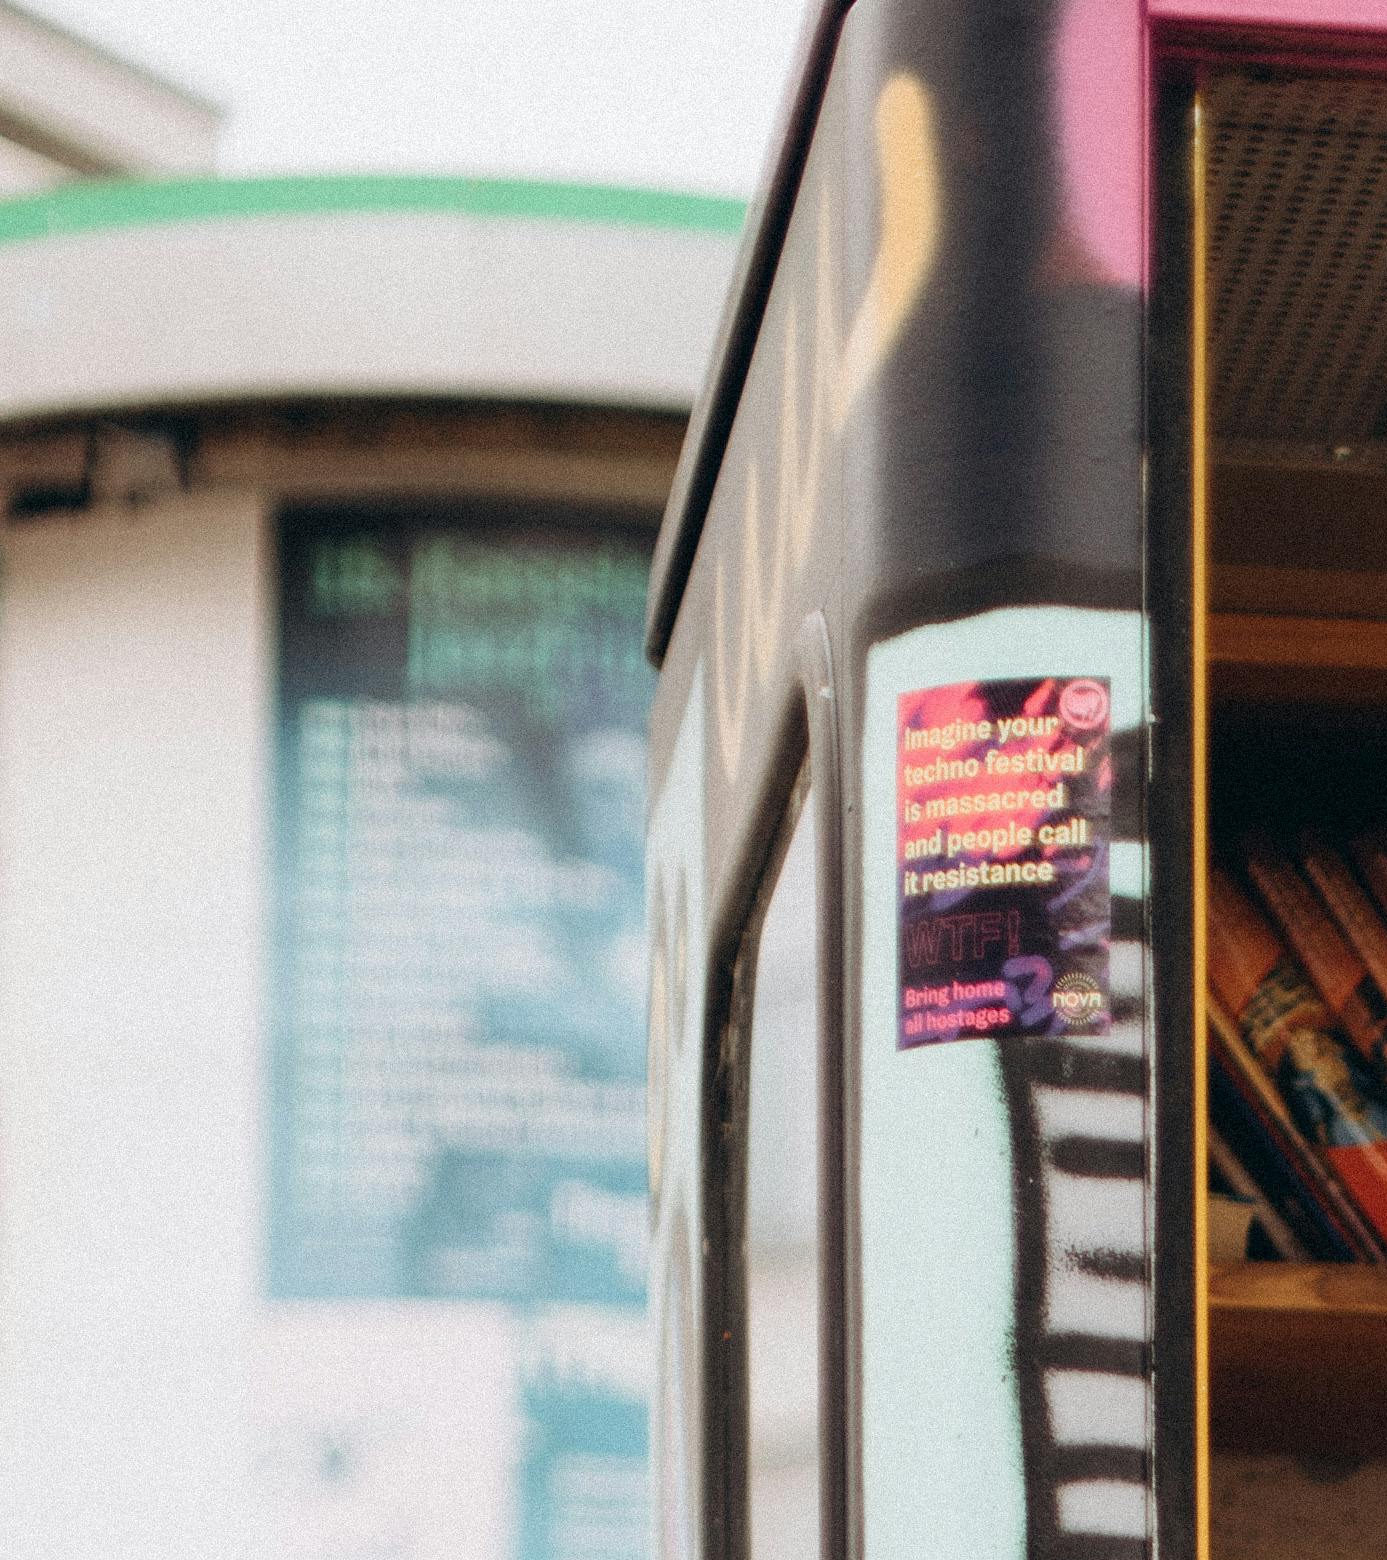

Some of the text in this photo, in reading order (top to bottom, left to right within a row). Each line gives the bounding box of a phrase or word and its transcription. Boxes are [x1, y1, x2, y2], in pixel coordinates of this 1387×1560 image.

[905, 717, 1058, 750] Imagine your
[905, 747, 1085, 785] techno festival
[905, 783, 1065, 822] is massacred
[905, 819, 1087, 859] and people call
[905, 861, 1054, 895] it resistance
[906, 907, 1020, 968] WTF!
[905, 980, 1005, 1009] Bring home
[906, 1008, 1011, 1034] all hostages
